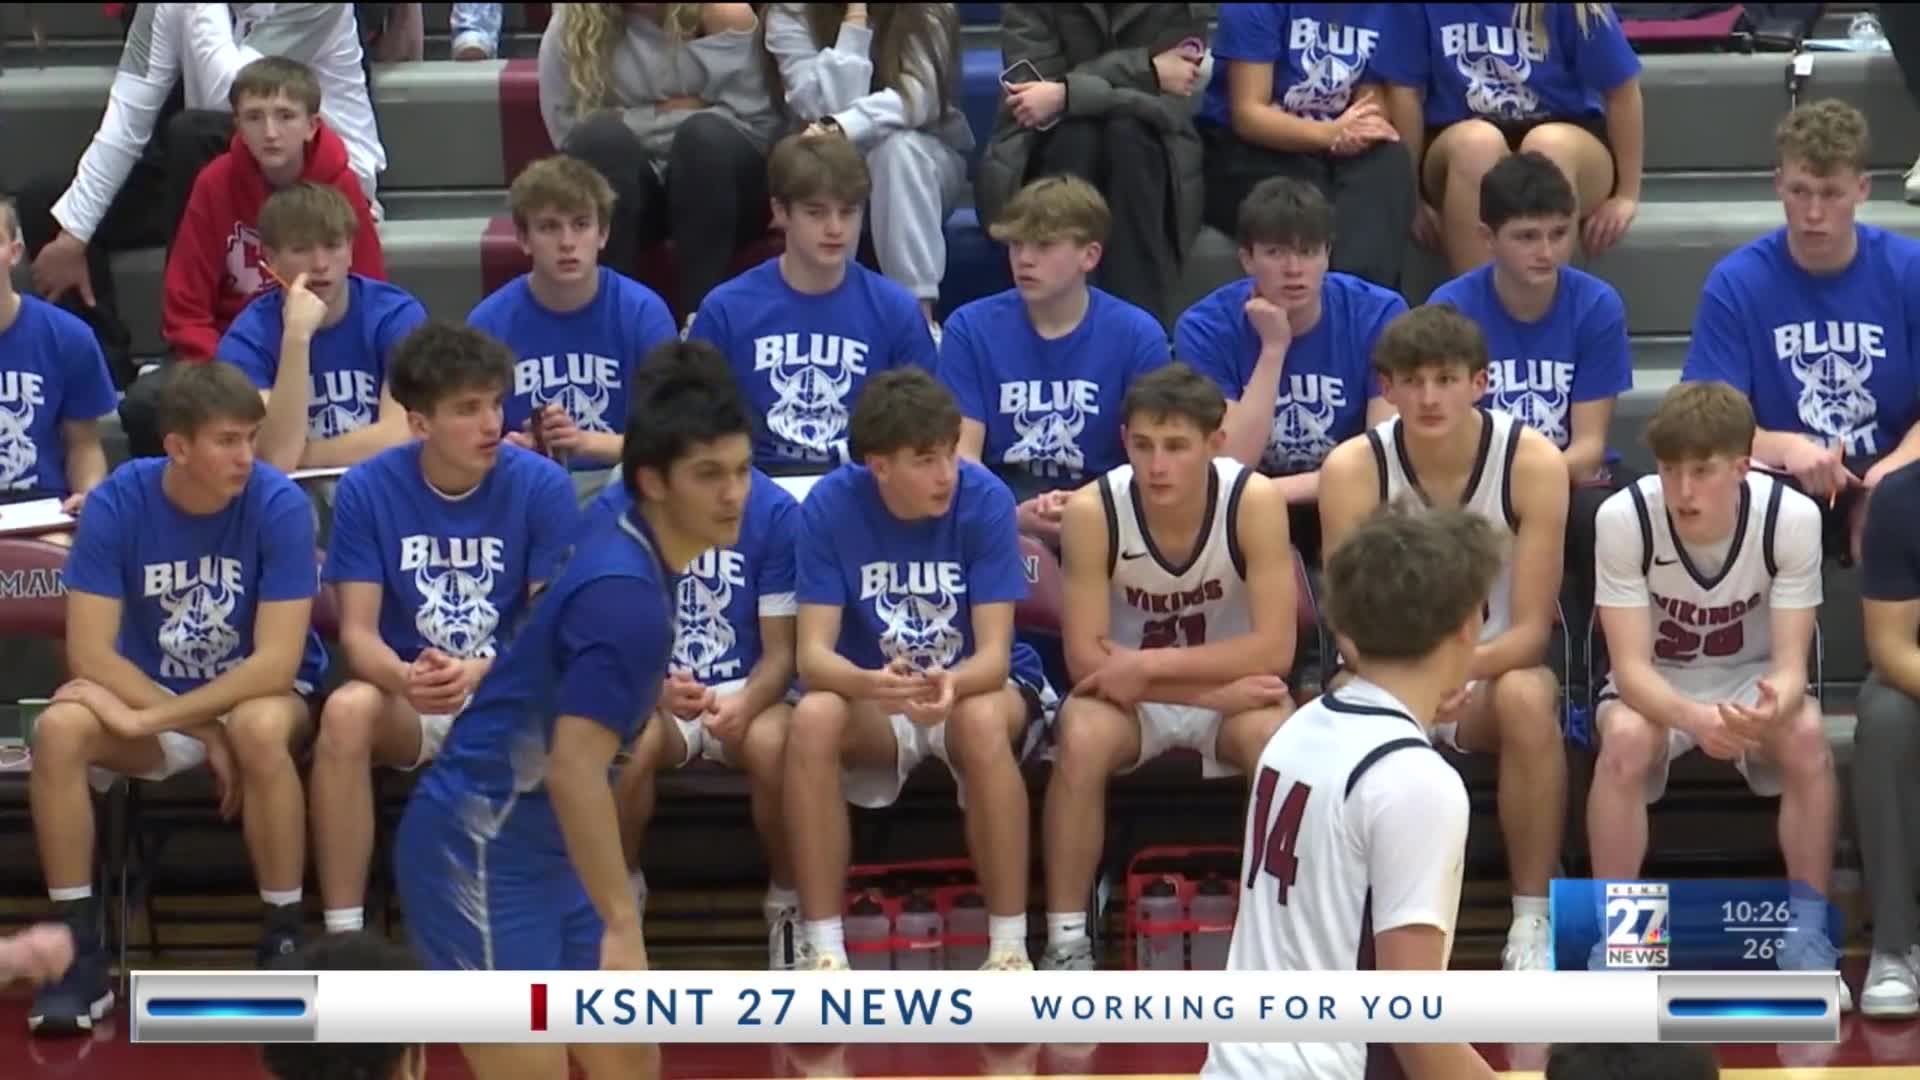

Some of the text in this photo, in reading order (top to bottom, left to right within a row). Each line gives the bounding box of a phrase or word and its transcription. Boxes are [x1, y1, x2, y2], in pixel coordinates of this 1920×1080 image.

[1440, 23, 1546, 62] BLUE
[753, 332, 869, 376] BLUE
[1774, 320, 1887, 360] BLUE
[513, 352, 622, 396] BLUE
[1484, 359, 1575, 394] BLUE
[1000, 380, 1099, 415] BLUE
[400, 534, 505, 572] BLUE
[143, 555, 245, 597] BLUE
[860, 561, 967, 600] BLUE
[1247, 765, 1312, 907] 14
